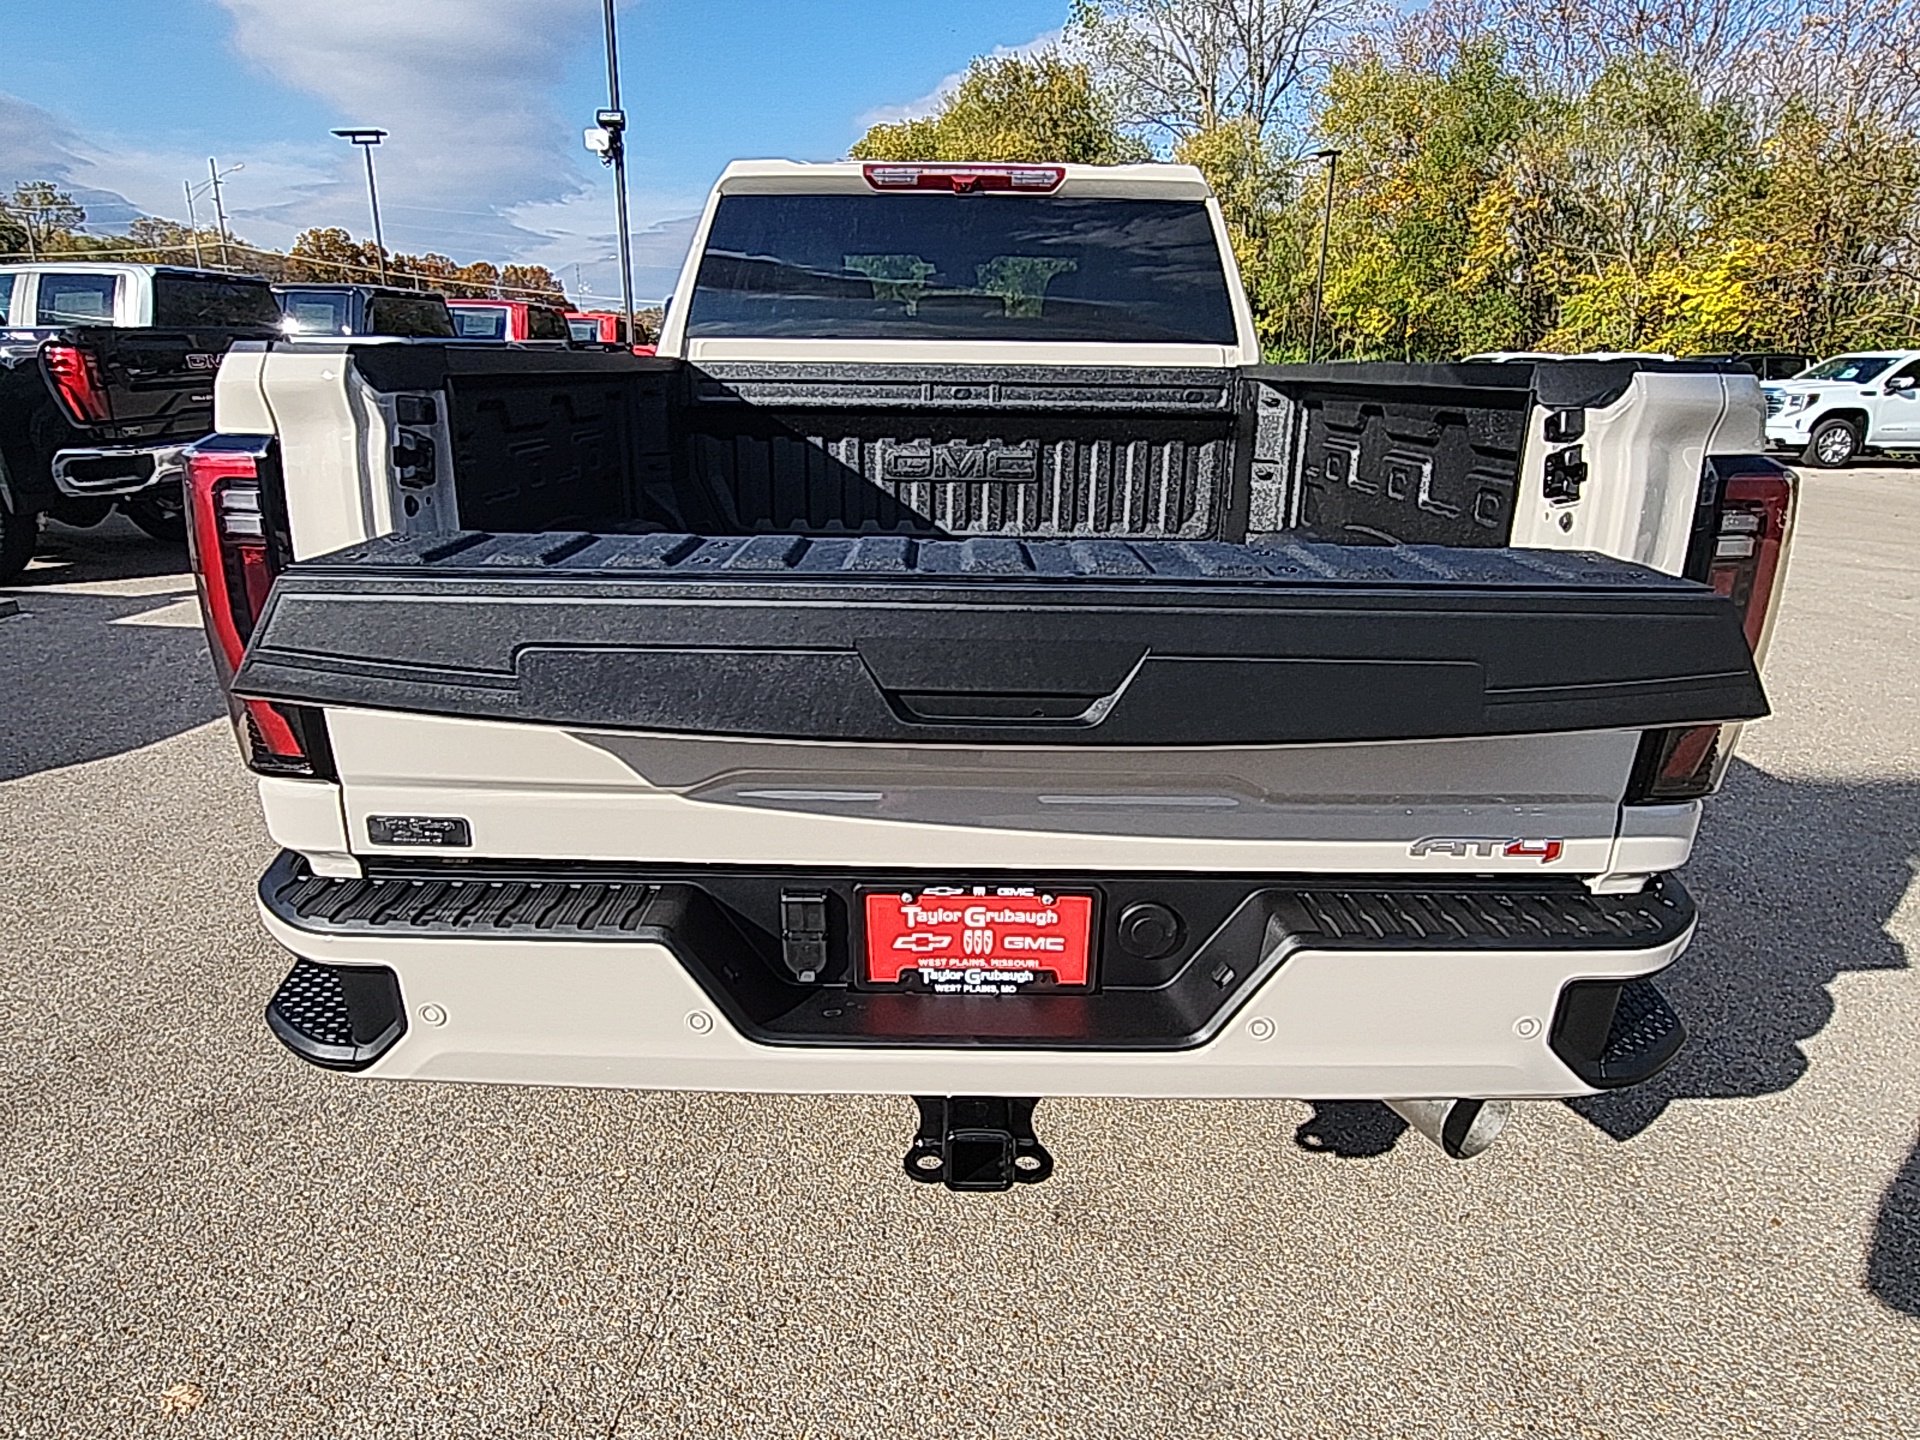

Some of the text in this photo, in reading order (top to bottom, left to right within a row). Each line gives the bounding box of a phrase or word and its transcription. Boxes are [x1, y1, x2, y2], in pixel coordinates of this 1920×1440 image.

[186, 353, 224, 369] GM
[883, 446, 1037, 482] GMC
[1409, 837, 1564, 865] AT4
[997, 888, 1034, 896] GMC
[900, 906, 1058, 928] Taylor Grubaugh
[1003, 937, 1065, 951] GMC
[918, 958, 947, 967] WEST
[990, 959, 1039, 967] MISSOURI
[918, 968, 1034, 984] Taylor Grubaugh
[934, 984, 962, 993] WEST
[1001, 985, 1017, 993] MO
